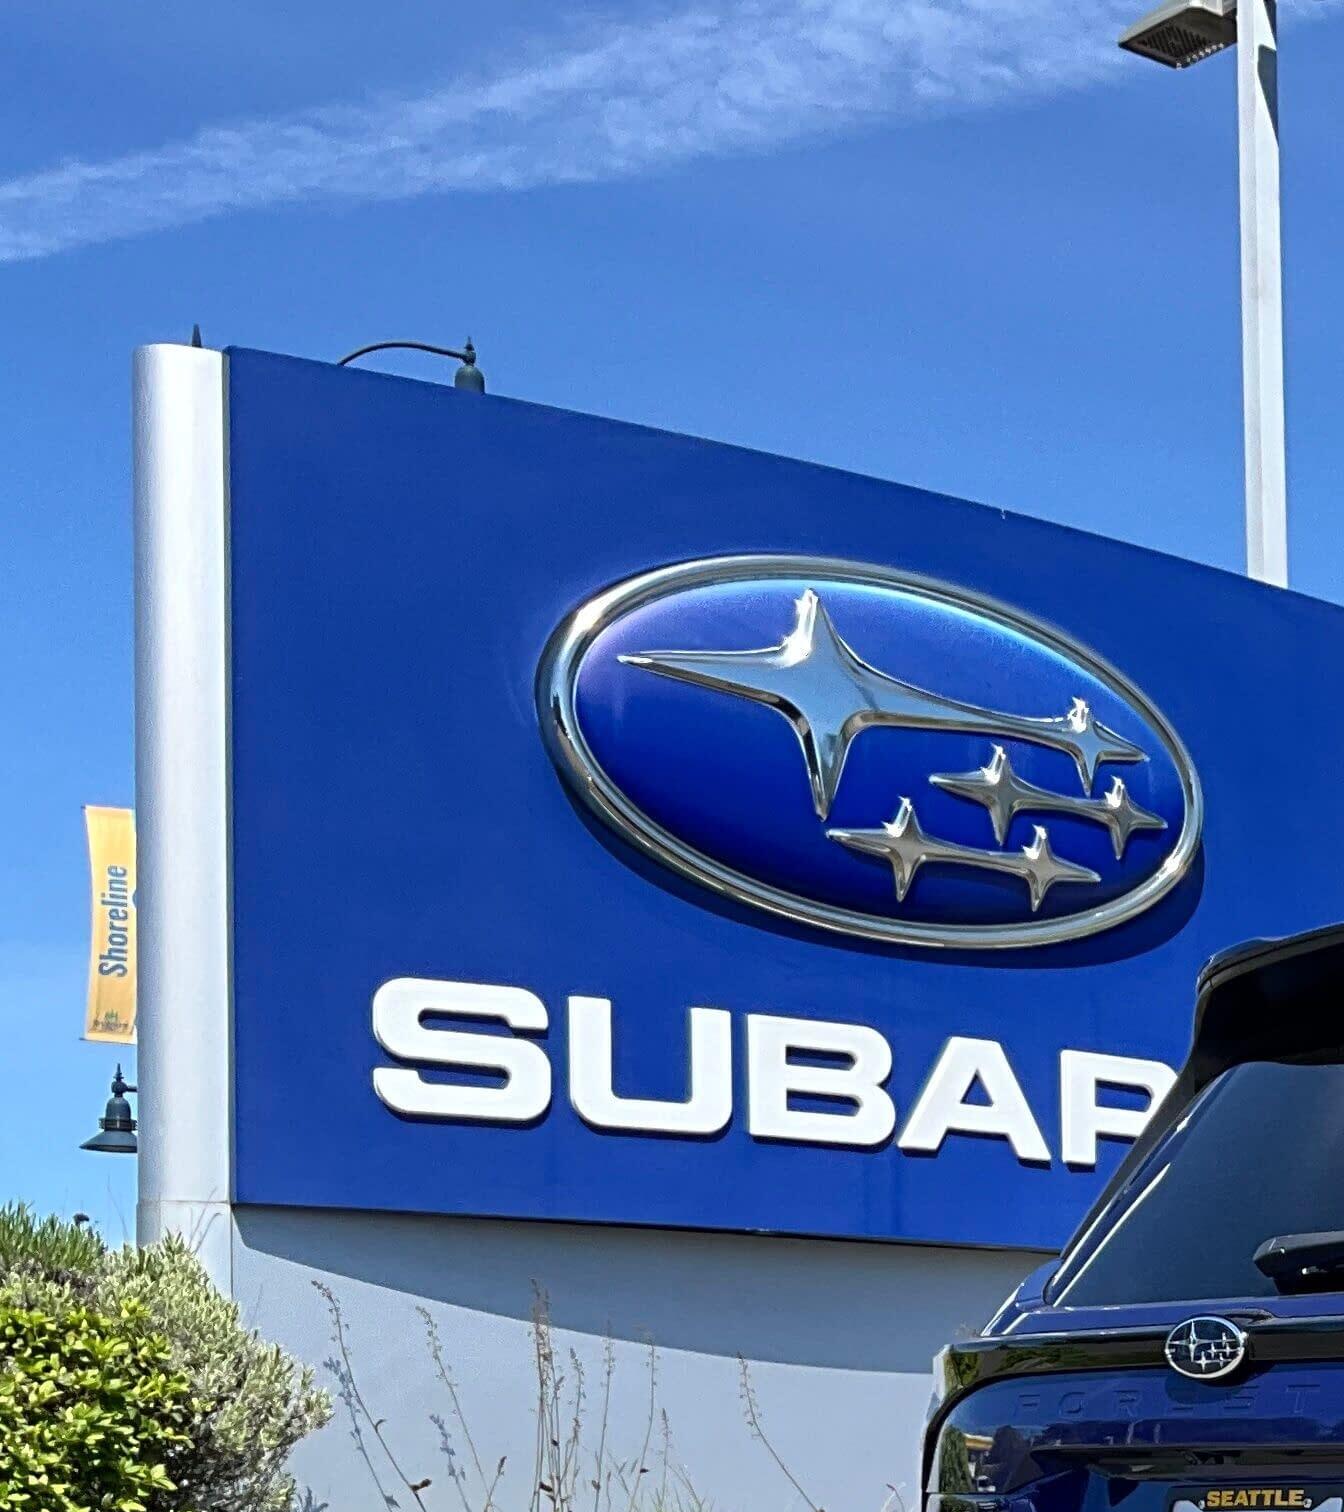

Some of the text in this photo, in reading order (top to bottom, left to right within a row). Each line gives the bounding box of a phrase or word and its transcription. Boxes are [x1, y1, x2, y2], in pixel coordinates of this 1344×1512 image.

[98, 863, 128, 977] Shoreline
[371, 976, 1180, 1166] SUBAR
[1206, 1488, 1304, 1508] SEATTLE
